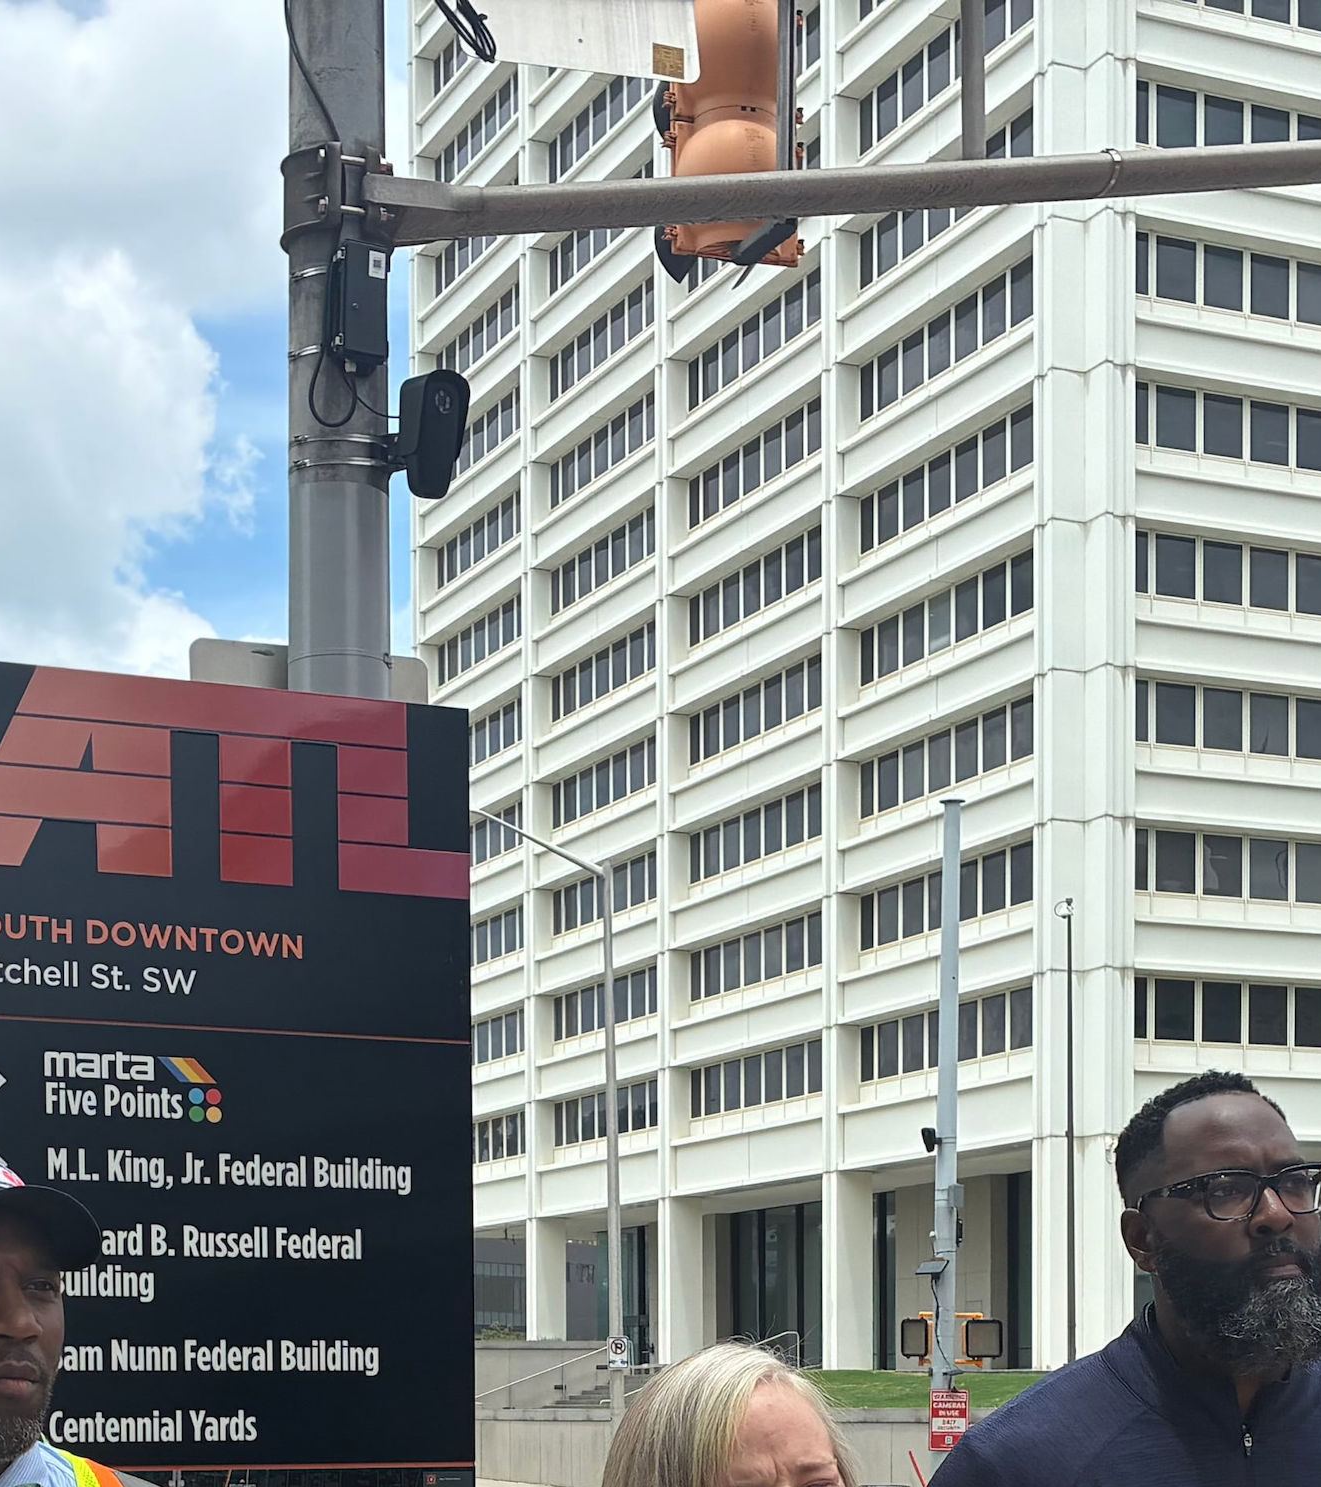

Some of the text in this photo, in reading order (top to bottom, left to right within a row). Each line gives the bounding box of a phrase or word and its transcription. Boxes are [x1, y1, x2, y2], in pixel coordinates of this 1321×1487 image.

[85, 918, 304, 960] DOWNTOWN
[89, 962, 132, 992] St.
[141, 966, 197, 996] SW
[44, 1050, 155, 1082] marta
[44, 1080, 184, 1121] Five Points
[46, 1146, 412, 1196] M.L. King, Jr. Federal Building
[150, 1223, 176, 1258] B.
[182, 1224, 269, 1260] Russell
[274, 1226, 363, 1261] Federal
[60, 1263, 156, 1303] uilding
[58, 1338, 380, 1377] am Nunn Federal Building
[48, 1409, 258, 1444] Centennial Yards
